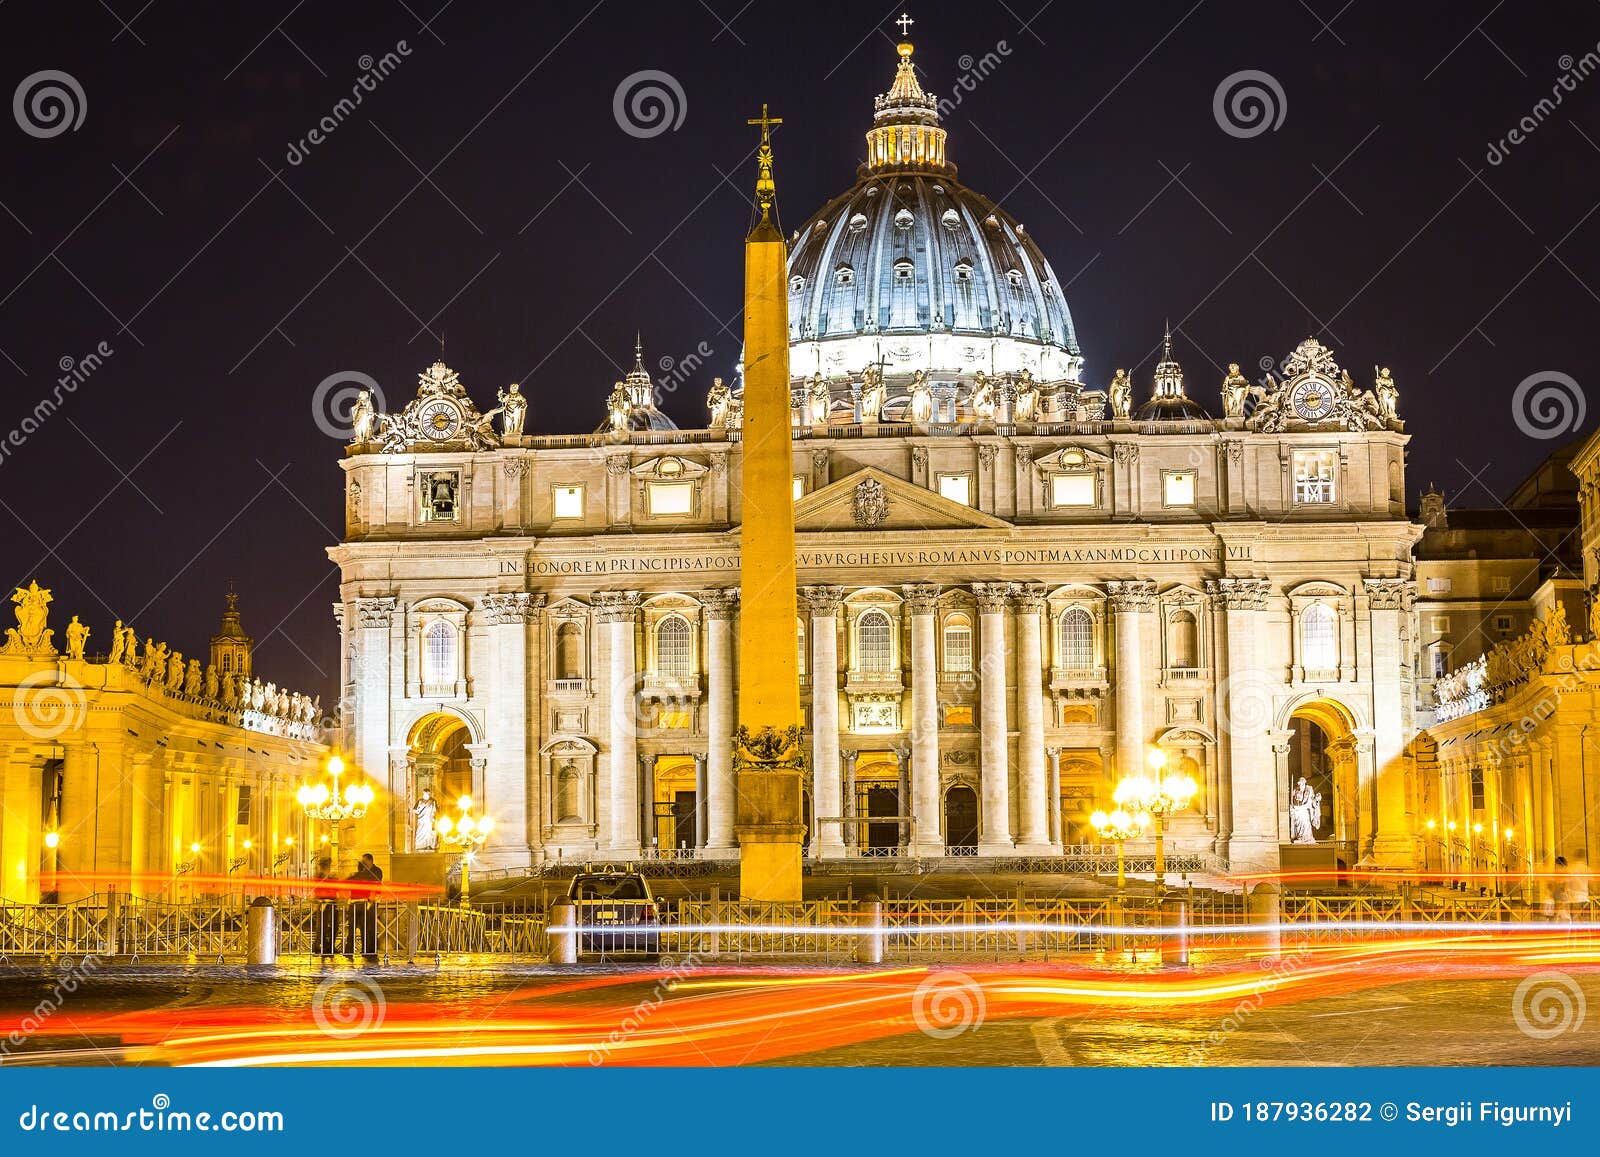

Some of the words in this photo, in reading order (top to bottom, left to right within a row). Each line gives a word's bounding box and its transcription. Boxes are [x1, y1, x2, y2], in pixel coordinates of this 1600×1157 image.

[815, 551, 914, 565] BVRGHESIVS
[919, 549, 1000, 563] ROMANVS
[1111, 548, 1175, 561] MDCXII
[1228, 546, 1251, 558] VII
[499, 561, 517, 573] IN
[526, 560, 606, 574] HONOREM
[611, 558, 691, 571] PRINCIPIS
